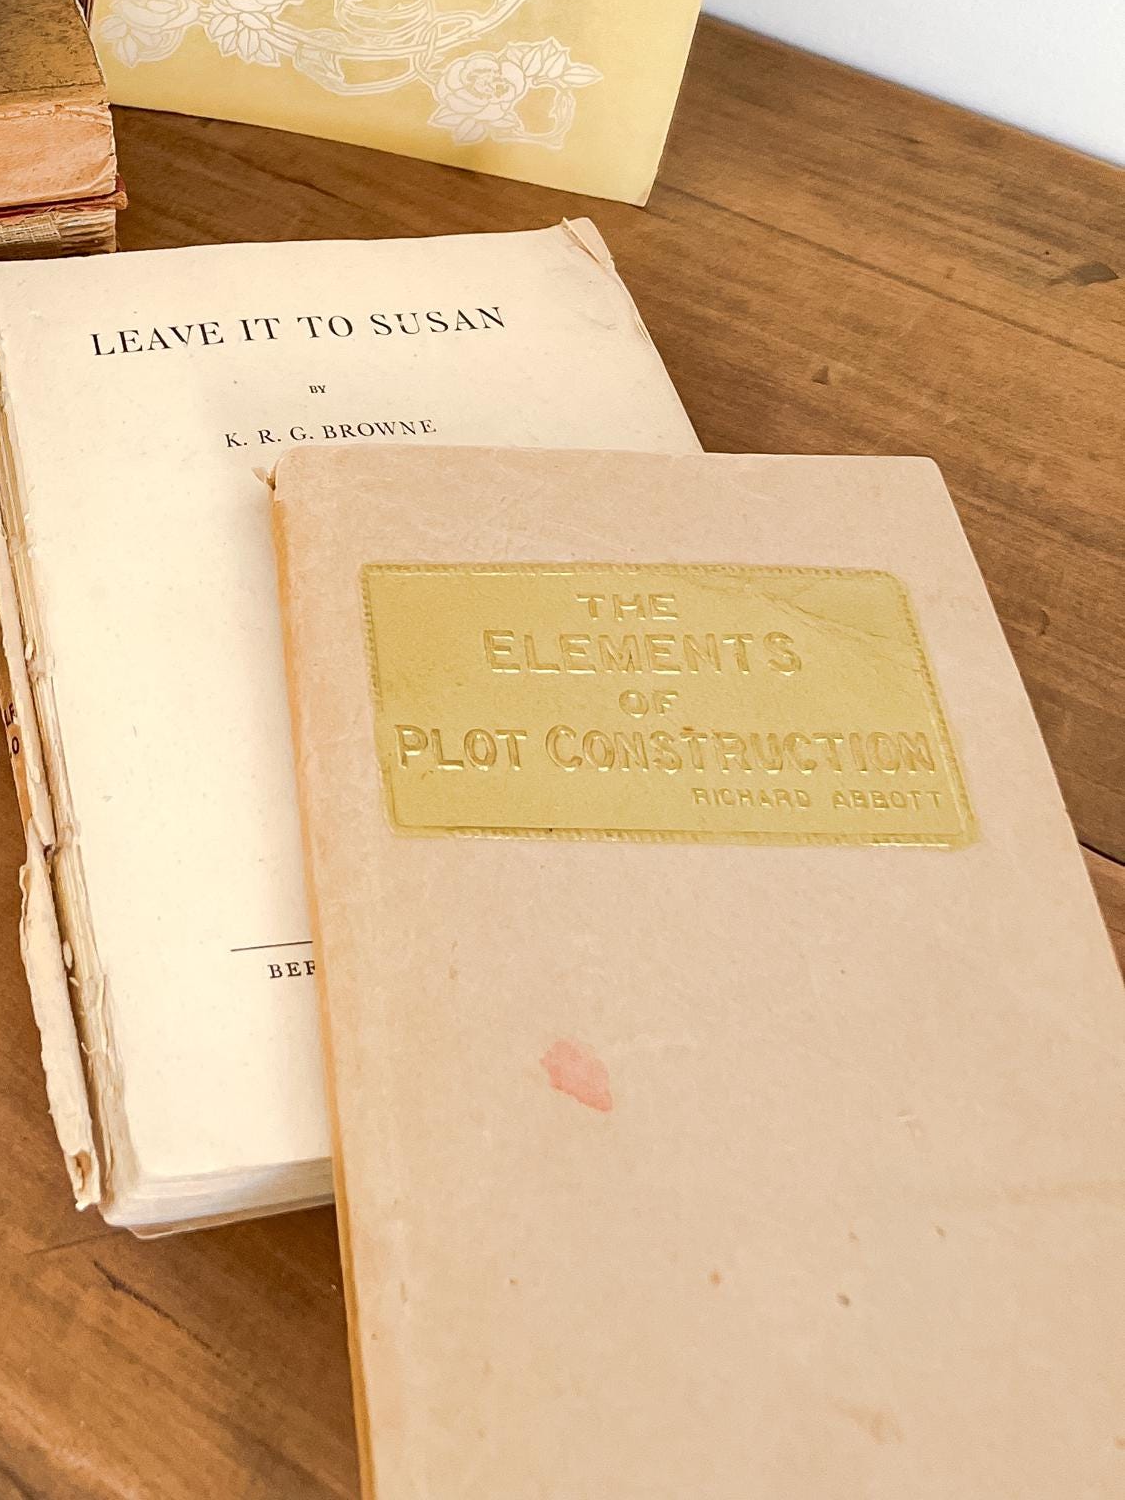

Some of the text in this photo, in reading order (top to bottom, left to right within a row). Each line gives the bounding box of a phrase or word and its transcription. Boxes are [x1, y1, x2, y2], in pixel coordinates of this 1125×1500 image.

[90, 306, 507, 357] LEAVE IT TO SUSAN
[308, 384, 327, 394] BY
[226, 419, 437, 448] K. R. G. BROWNE
[576, 593, 678, 620] THE
[482, 629, 803, 675] ELEMENTS
[618, 690, 678, 718] OF
[396, 724, 937, 774] PLOT CONSTRUCTION
[692, 788, 943, 810] RICHARD ABBOTT
